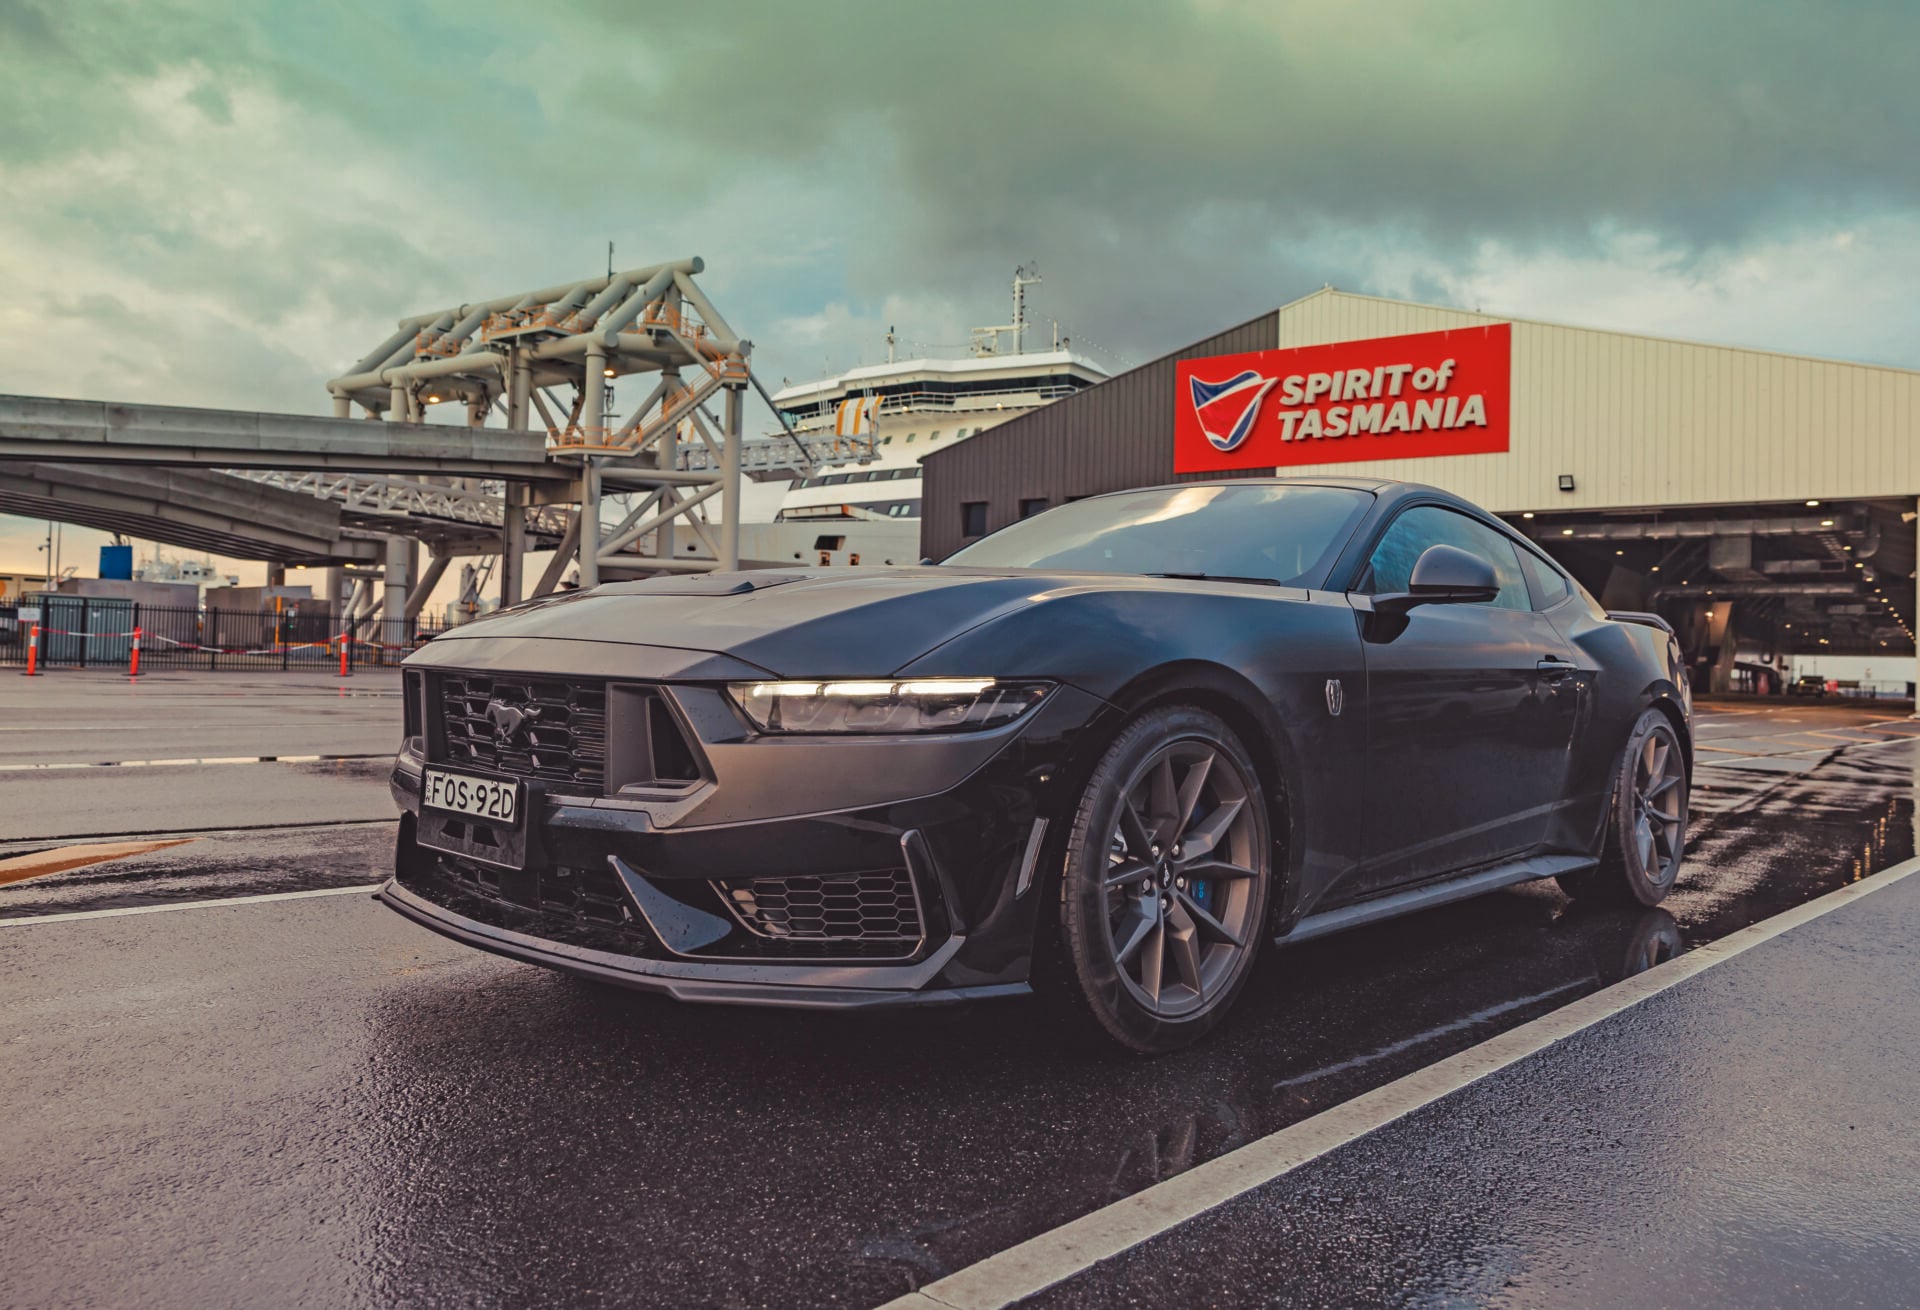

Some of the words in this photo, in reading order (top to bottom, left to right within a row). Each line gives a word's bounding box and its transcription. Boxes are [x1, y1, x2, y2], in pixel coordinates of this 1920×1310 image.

[1279, 363, 1413, 405] SPIRIT
[1413, 358, 1455, 392] of
[1278, 394, 1487, 441] TASMANIA
